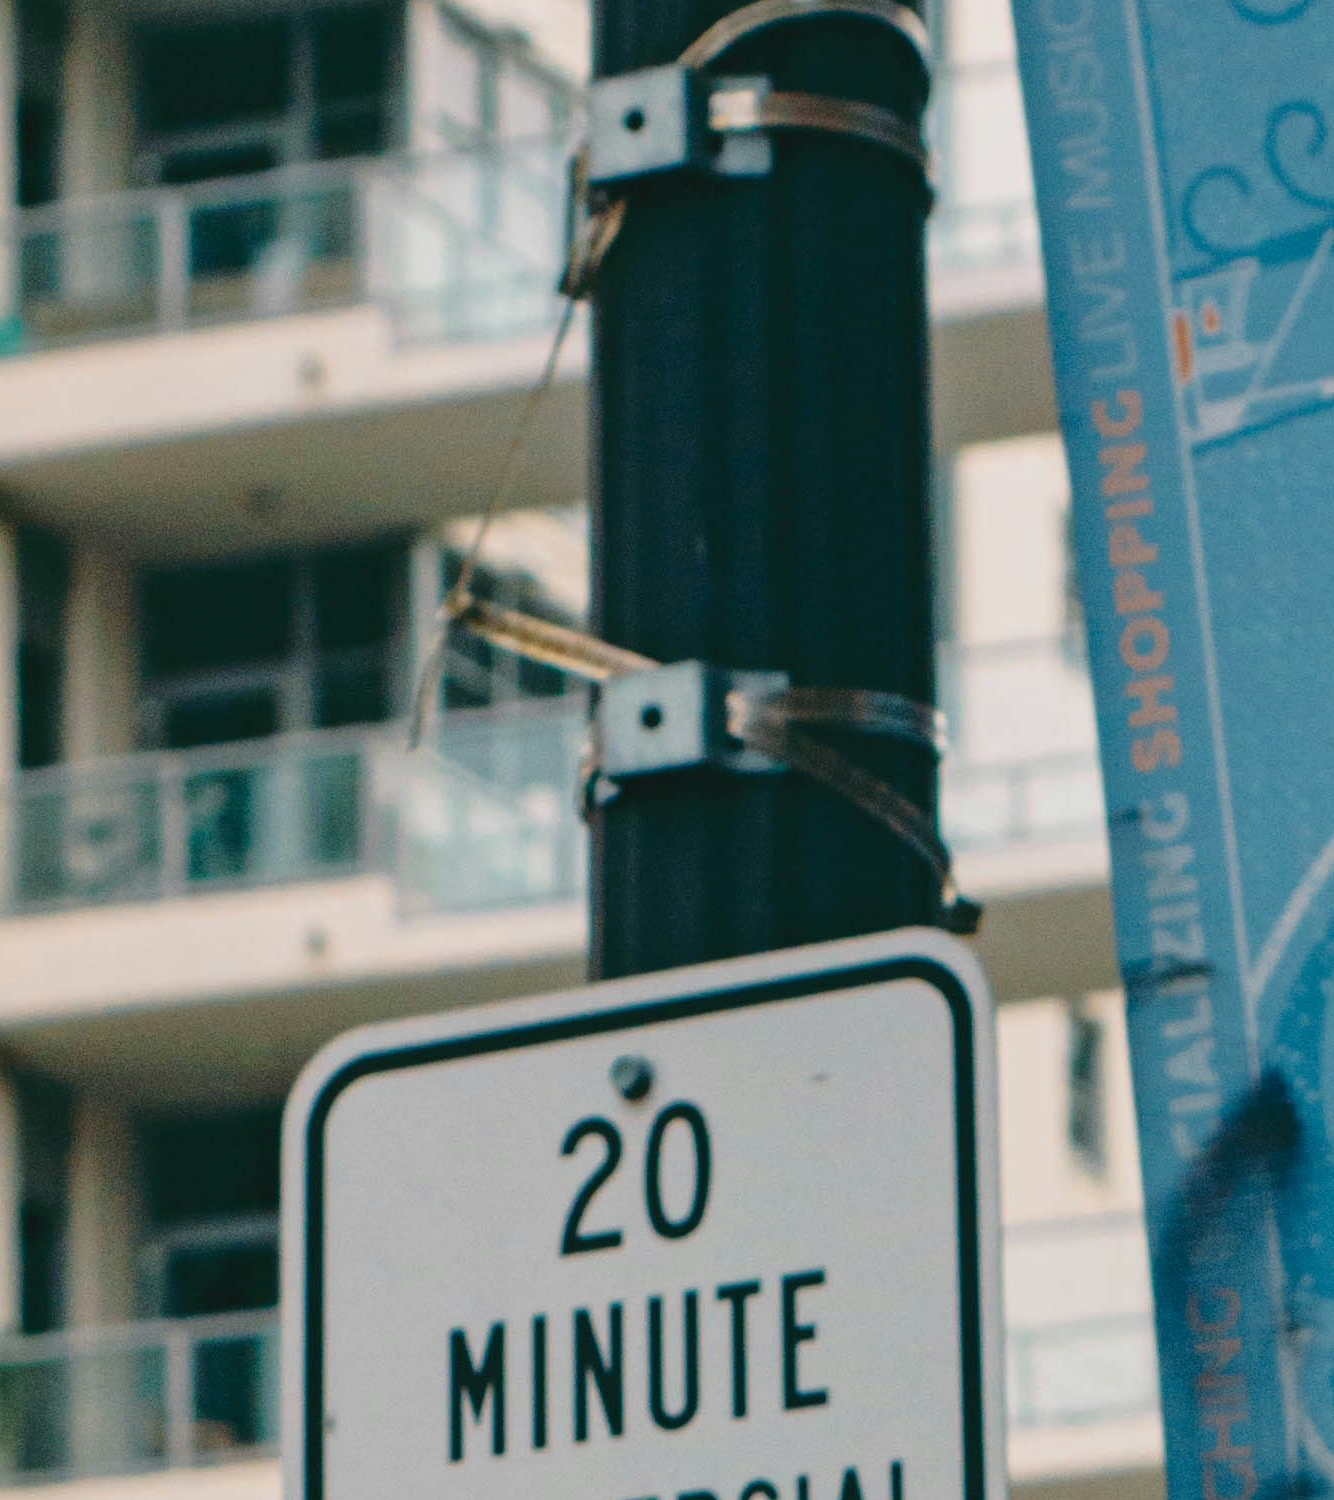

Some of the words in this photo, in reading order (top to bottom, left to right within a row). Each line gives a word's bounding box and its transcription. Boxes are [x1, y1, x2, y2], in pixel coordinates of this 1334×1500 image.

[1039, 0, 1116, 210] MUSIC
[1070, 232, 1141, 380] LIVE
[1092, 388, 1183, 773] SHOPPING
[559, 1098, 712, 1255] 20
[448, 1269, 830, 1462] MINUTE
